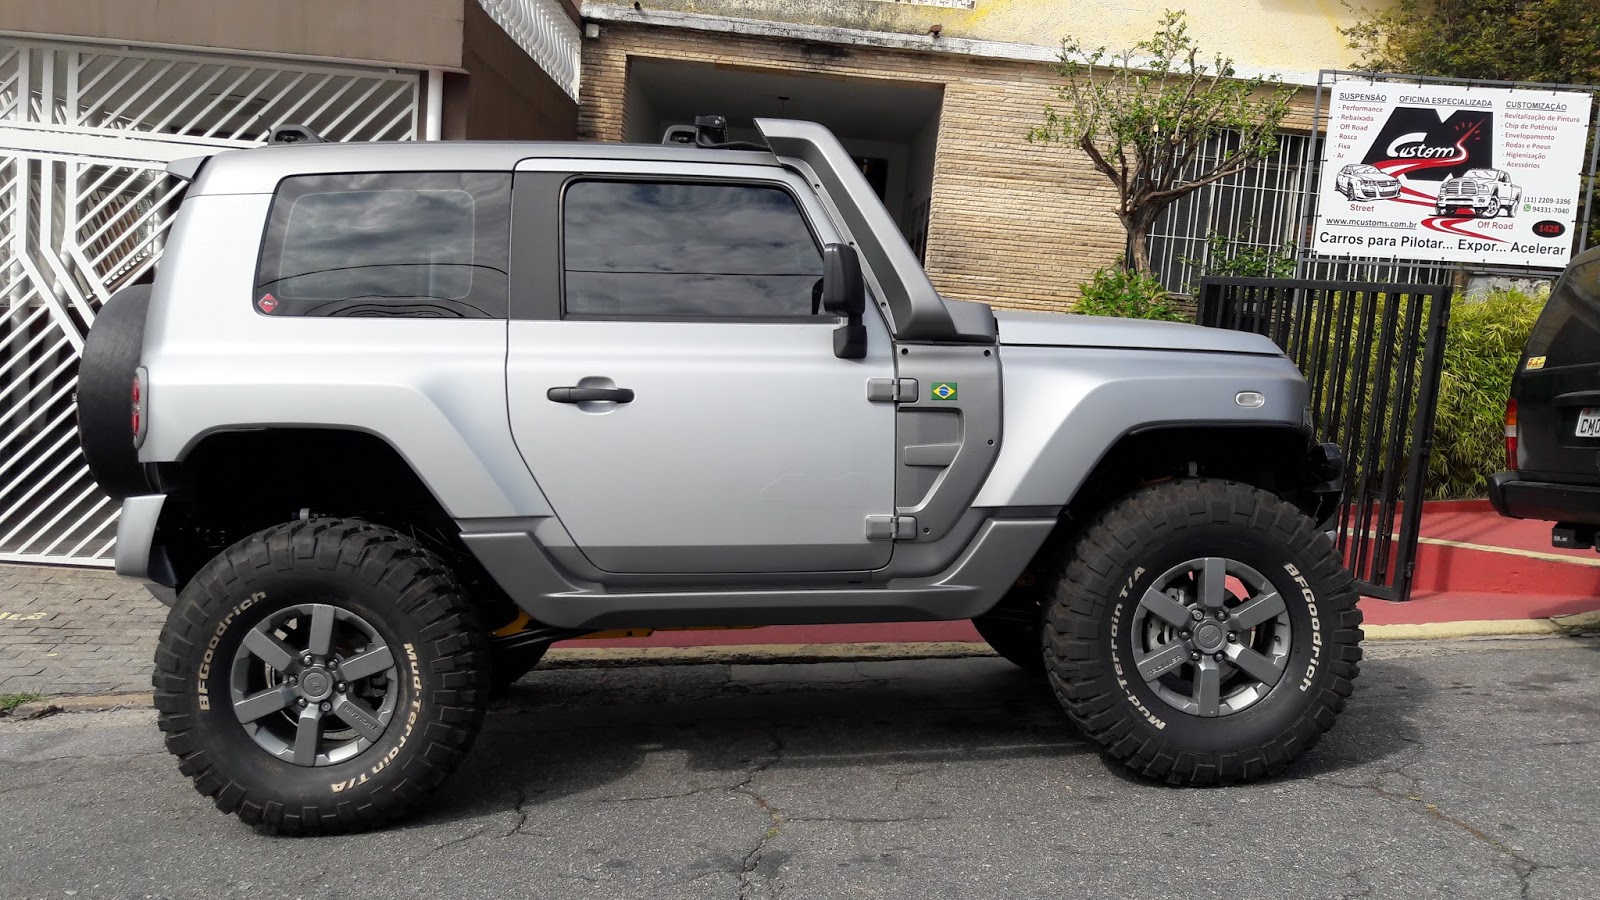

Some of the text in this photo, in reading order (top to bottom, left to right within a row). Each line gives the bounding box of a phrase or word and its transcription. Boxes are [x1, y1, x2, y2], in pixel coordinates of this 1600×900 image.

[1339, 92, 1387, 102] SUSPENSÃO
[1432, 97, 1492, 106] ESPECIALIZADA
[1342, 104, 1383, 112] Performance
[1506, 101, 1567, 111] CUSTOMIZAÇÃO
[1504, 113, 1546, 121] Revitalização
[1505, 132, 1554, 140] Envelopamento
[1350, 204, 1374, 212] Street
[1326, 218, 1417, 228] www.mcustoms.com.br
[1539, 225, 1560, 233] 1428
[1320, 232, 1566, 255] Carros para Pilotar... Expor... Acelerar
[1283, 563, 1323, 692] BFGoodrich
[198, 590, 267, 711] BFGoodrich
[1110, 566, 1166, 730] Mud-Terrain T/A
[331, 643, 422, 793] Mud-Terrain T/A
